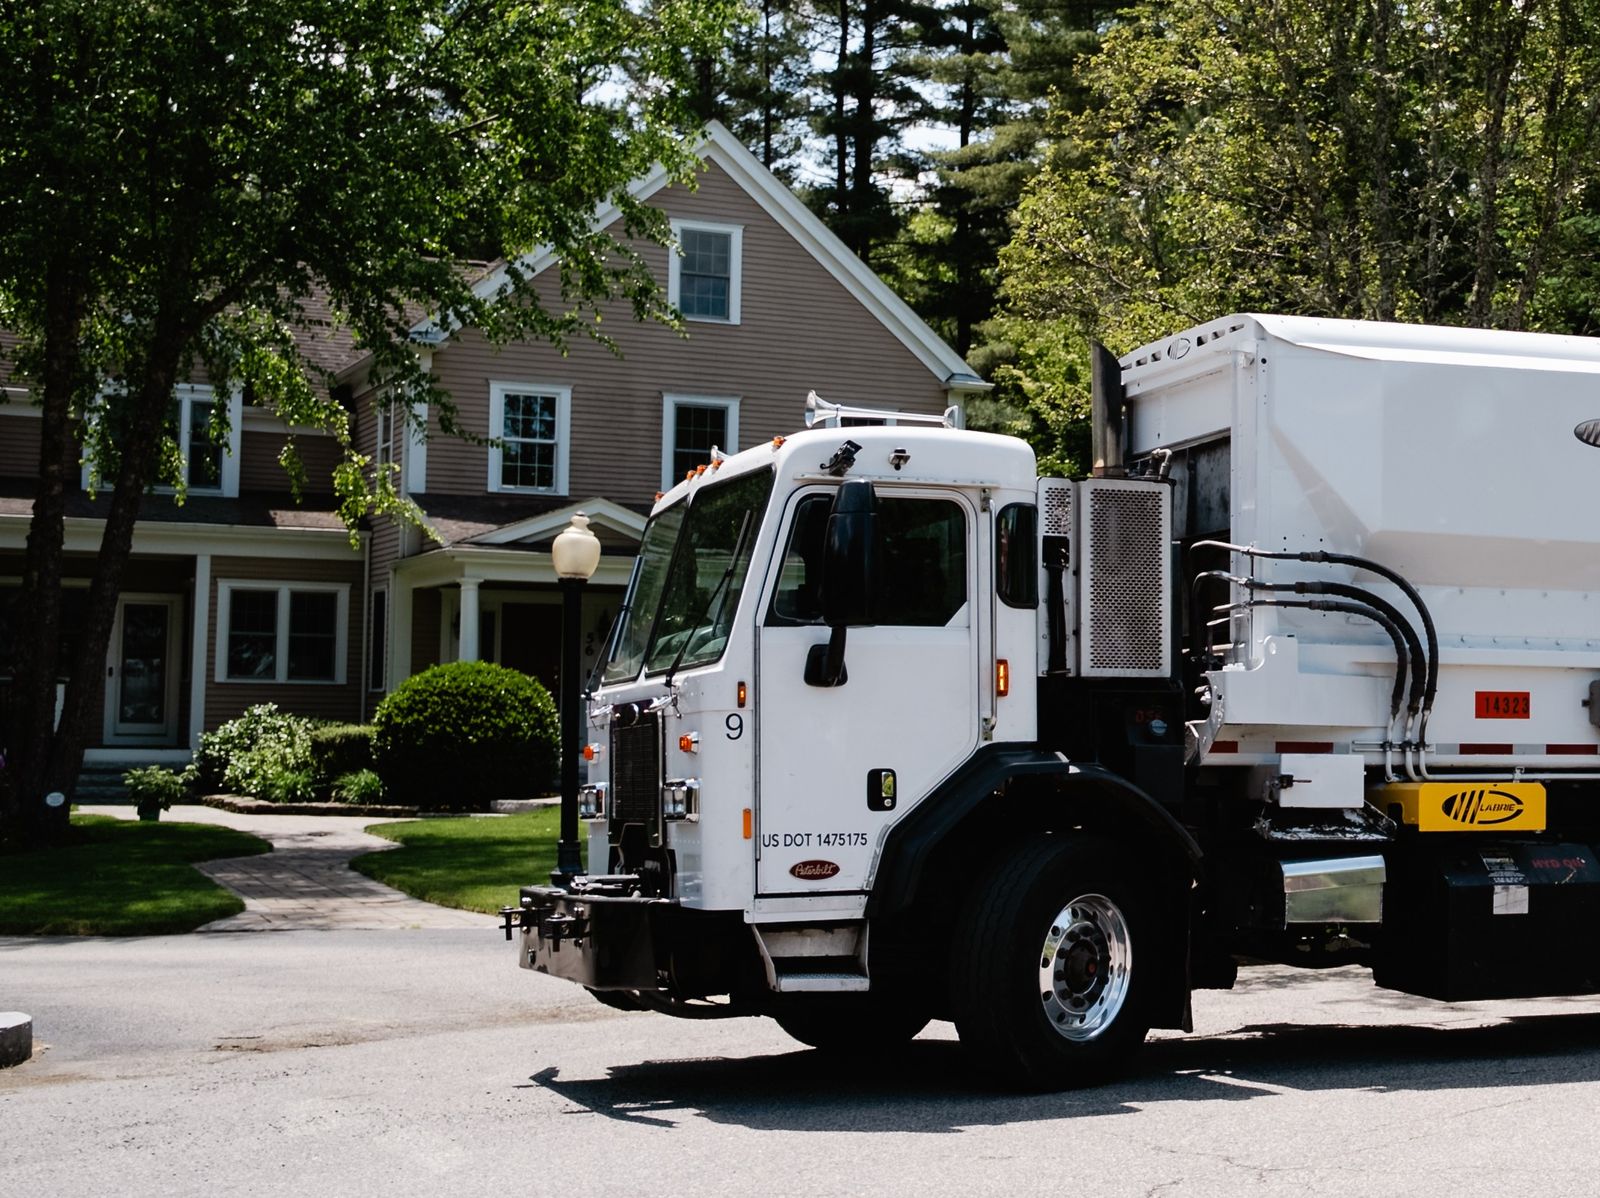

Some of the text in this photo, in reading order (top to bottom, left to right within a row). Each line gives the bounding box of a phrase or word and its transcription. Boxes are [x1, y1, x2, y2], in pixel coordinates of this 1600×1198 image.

[1485, 696, 1531, 715] 14323
[725, 712, 744, 741] 9
[1479, 803, 1516, 812] LABRIE
[762, 832, 868, 848] US DOT 1475175
[794, 863, 836, 876] Peterbilt
